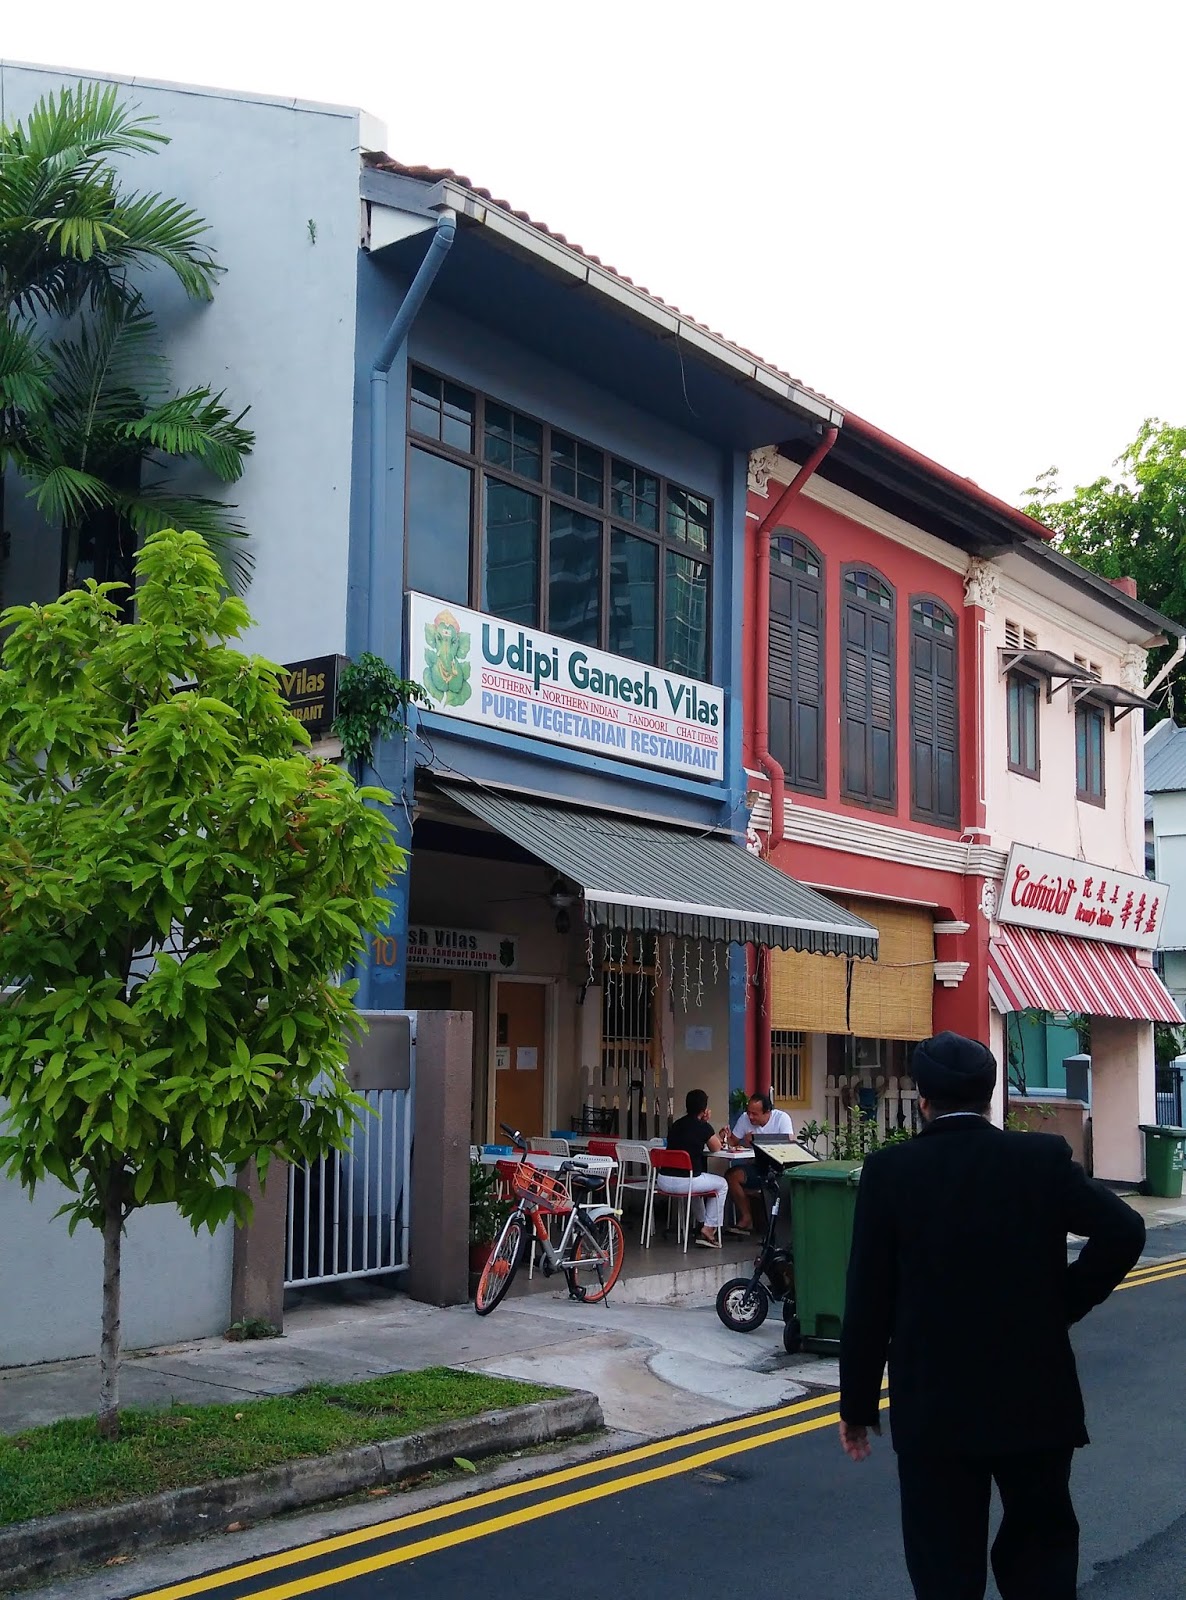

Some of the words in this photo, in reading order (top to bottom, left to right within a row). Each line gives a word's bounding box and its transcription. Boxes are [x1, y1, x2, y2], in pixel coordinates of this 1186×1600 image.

[281, 668, 325, 697] Vilas
[481, 622, 559, 691] Udipi
[568, 650, 658, 710] Ganesh
[663, 678, 719, 727] Vilas
[481, 672, 532, 696] SOUTHERN
[542, 688, 589, 712] NORTHERN
[590, 702, 619, 720] INDIAN
[628, 712, 669, 733] TANDOORI
[676, 726, 697, 740] CHAT
[697, 731, 719, 746] ITEMS
[481, 690, 528, 725] PURE
[531, 703, 627, 749] VEGETARIAN
[631, 729, 719, 771] RESTAURANT
[371, 936, 398, 967] 10
[435, 930, 478, 951] Vilas
